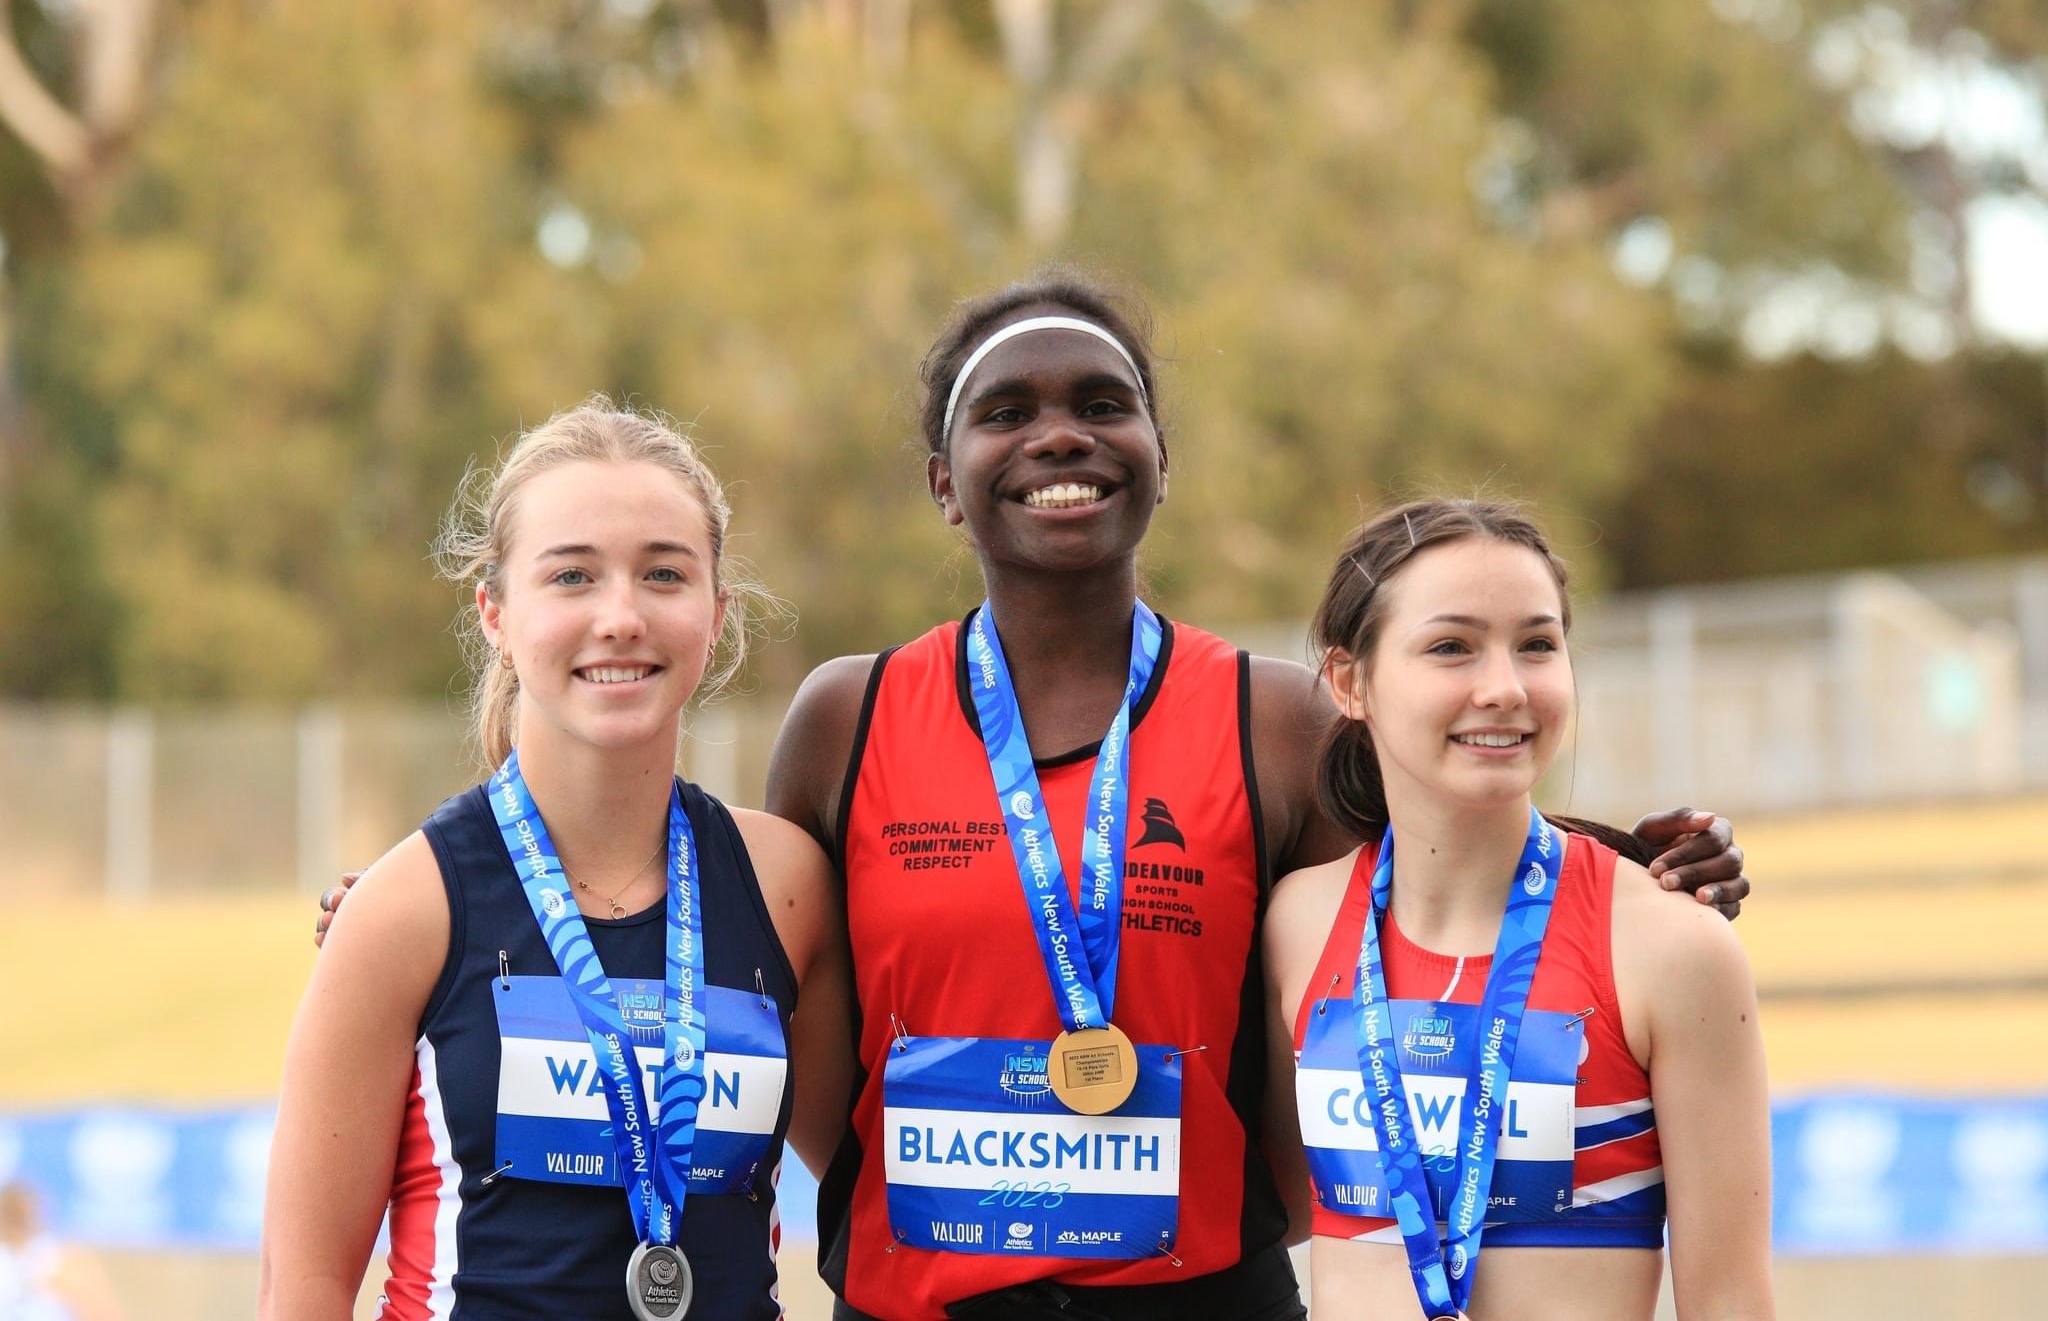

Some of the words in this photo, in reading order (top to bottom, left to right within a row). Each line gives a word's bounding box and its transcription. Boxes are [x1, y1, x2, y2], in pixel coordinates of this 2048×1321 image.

[978, 648, 996, 689] Wales
[501, 782, 523, 817] New
[1101, 777, 1117, 811] New
[881, 821, 961, 838] PERSONAL
[966, 821, 1008, 835] BEST
[1097, 813, 1114, 859] South
[516, 819, 551, 879] Athletics
[678, 834, 690, 876] Wales
[889, 839, 995, 856] COMMITMENT
[903, 856, 972, 871] RESPECT
[1093, 859, 1112, 910] Wales
[1123, 862, 1204, 886] DEAVOUR
[1136, 885, 1178, 897] SPORTS
[680, 880, 692, 928] South
[1148, 900, 1195, 914] SCHOOL
[1022, 828, 1049, 889] Athletics
[1040, 894, 1061, 931] New
[1051, 934, 1078, 981] South
[1067, 983, 1088, 1030] Wales
[1120, 912, 1203, 936] THLETICS
[678, 929, 692, 962] New
[1360, 943, 1374, 1006] Athletics
[621, 1009, 630, 1019] LL
[633, 1010, 666, 1021] SCHOOL
[622, 994, 660, 1009] NSW
[678, 966, 693, 1030] Athletics
[1365, 1009, 1382, 1046] New
[1403, 1034, 1416, 1045] ALL
[1419, 1035, 1456, 1047] SCHOOLS
[1412, 1018, 1449, 1034] NSW
[1482, 1018, 1505, 1069] Wales
[605, 1033, 630, 1081] Wales
[1008, 1057, 1047, 1072] NSW
[1370, 1049, 1389, 1098] South
[1000, 1074, 1014, 1084] ALL
[1018, 1074, 1049, 1085] SCHOOL
[1473, 1068, 1495, 1119] South
[617, 1083, 640, 1132] South
[1382, 1099, 1401, 1148] Wales
[630, 1134, 649, 1173] New
[899, 1126, 1159, 1171] BLACKSMITH
[1467, 1120, 1485, 1161] New
[546, 1152, 604, 1176] VALOUR
[692, 1167, 725, 1178] MAPLE
[978, 1180, 1072, 1209] 2023
[1334, 1184, 1378, 1206] VALOUR
[1487, 1197, 1517, 1206] APLE
[1457, 1167, 1479, 1237] Athletics
[931, 1221, 983, 1244] VALOUR
[1082, 1231, 1120, 1242] MAPLE
[647, 1285, 678, 1297] Athletics
